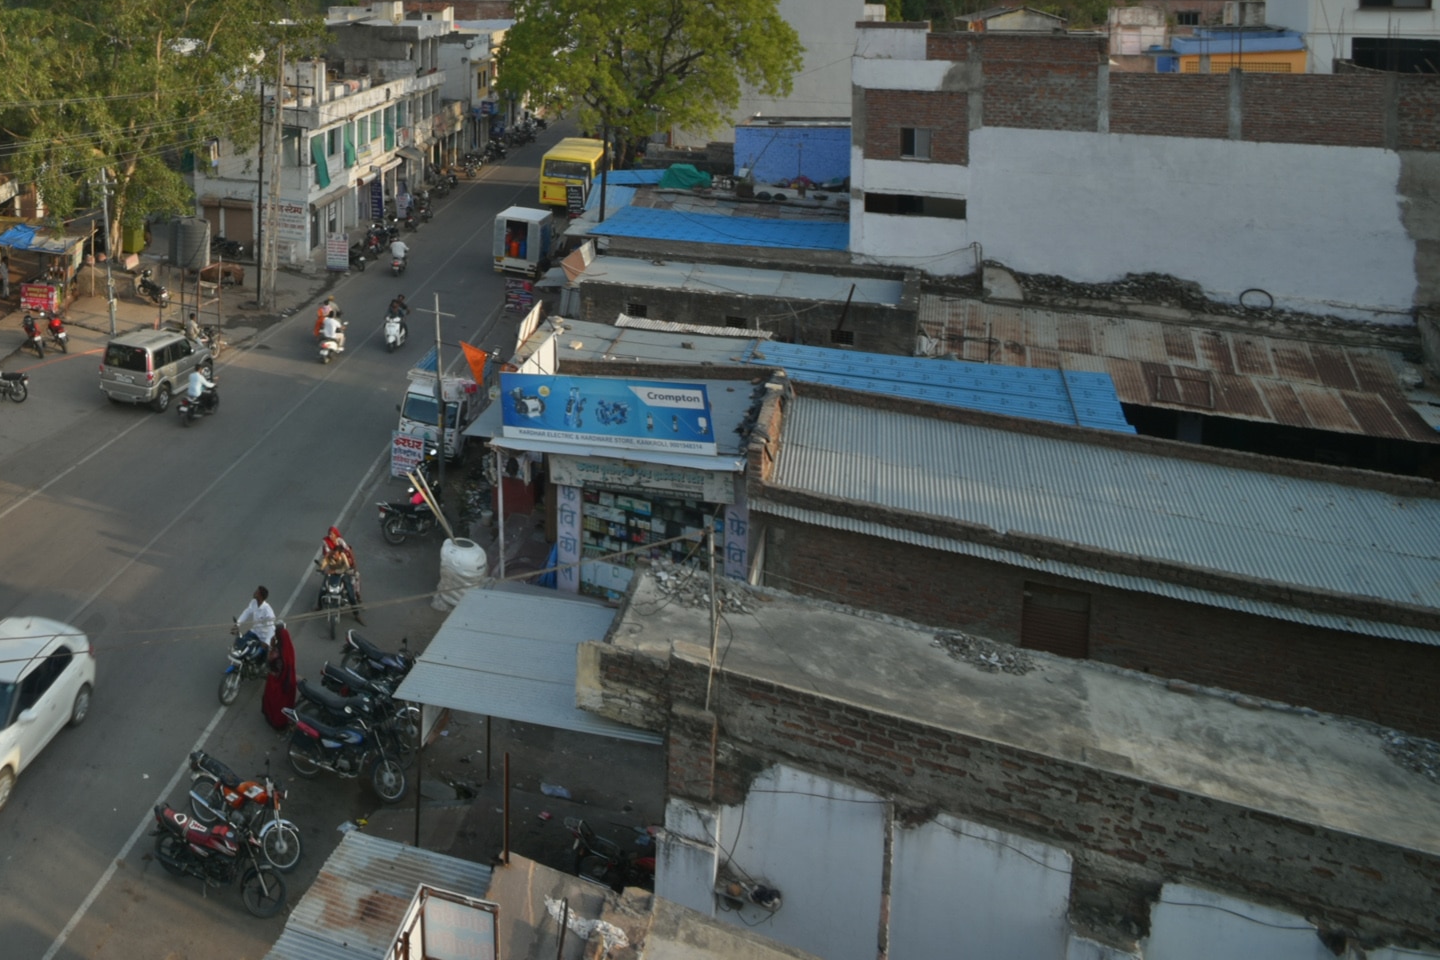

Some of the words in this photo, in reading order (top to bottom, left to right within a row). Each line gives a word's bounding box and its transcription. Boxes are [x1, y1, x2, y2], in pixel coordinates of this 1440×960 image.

[647, 391, 701, 404] Crompton
[547, 431, 574, 440] ELECTRIC
[580, 435, 613, 443] HARDWARE
